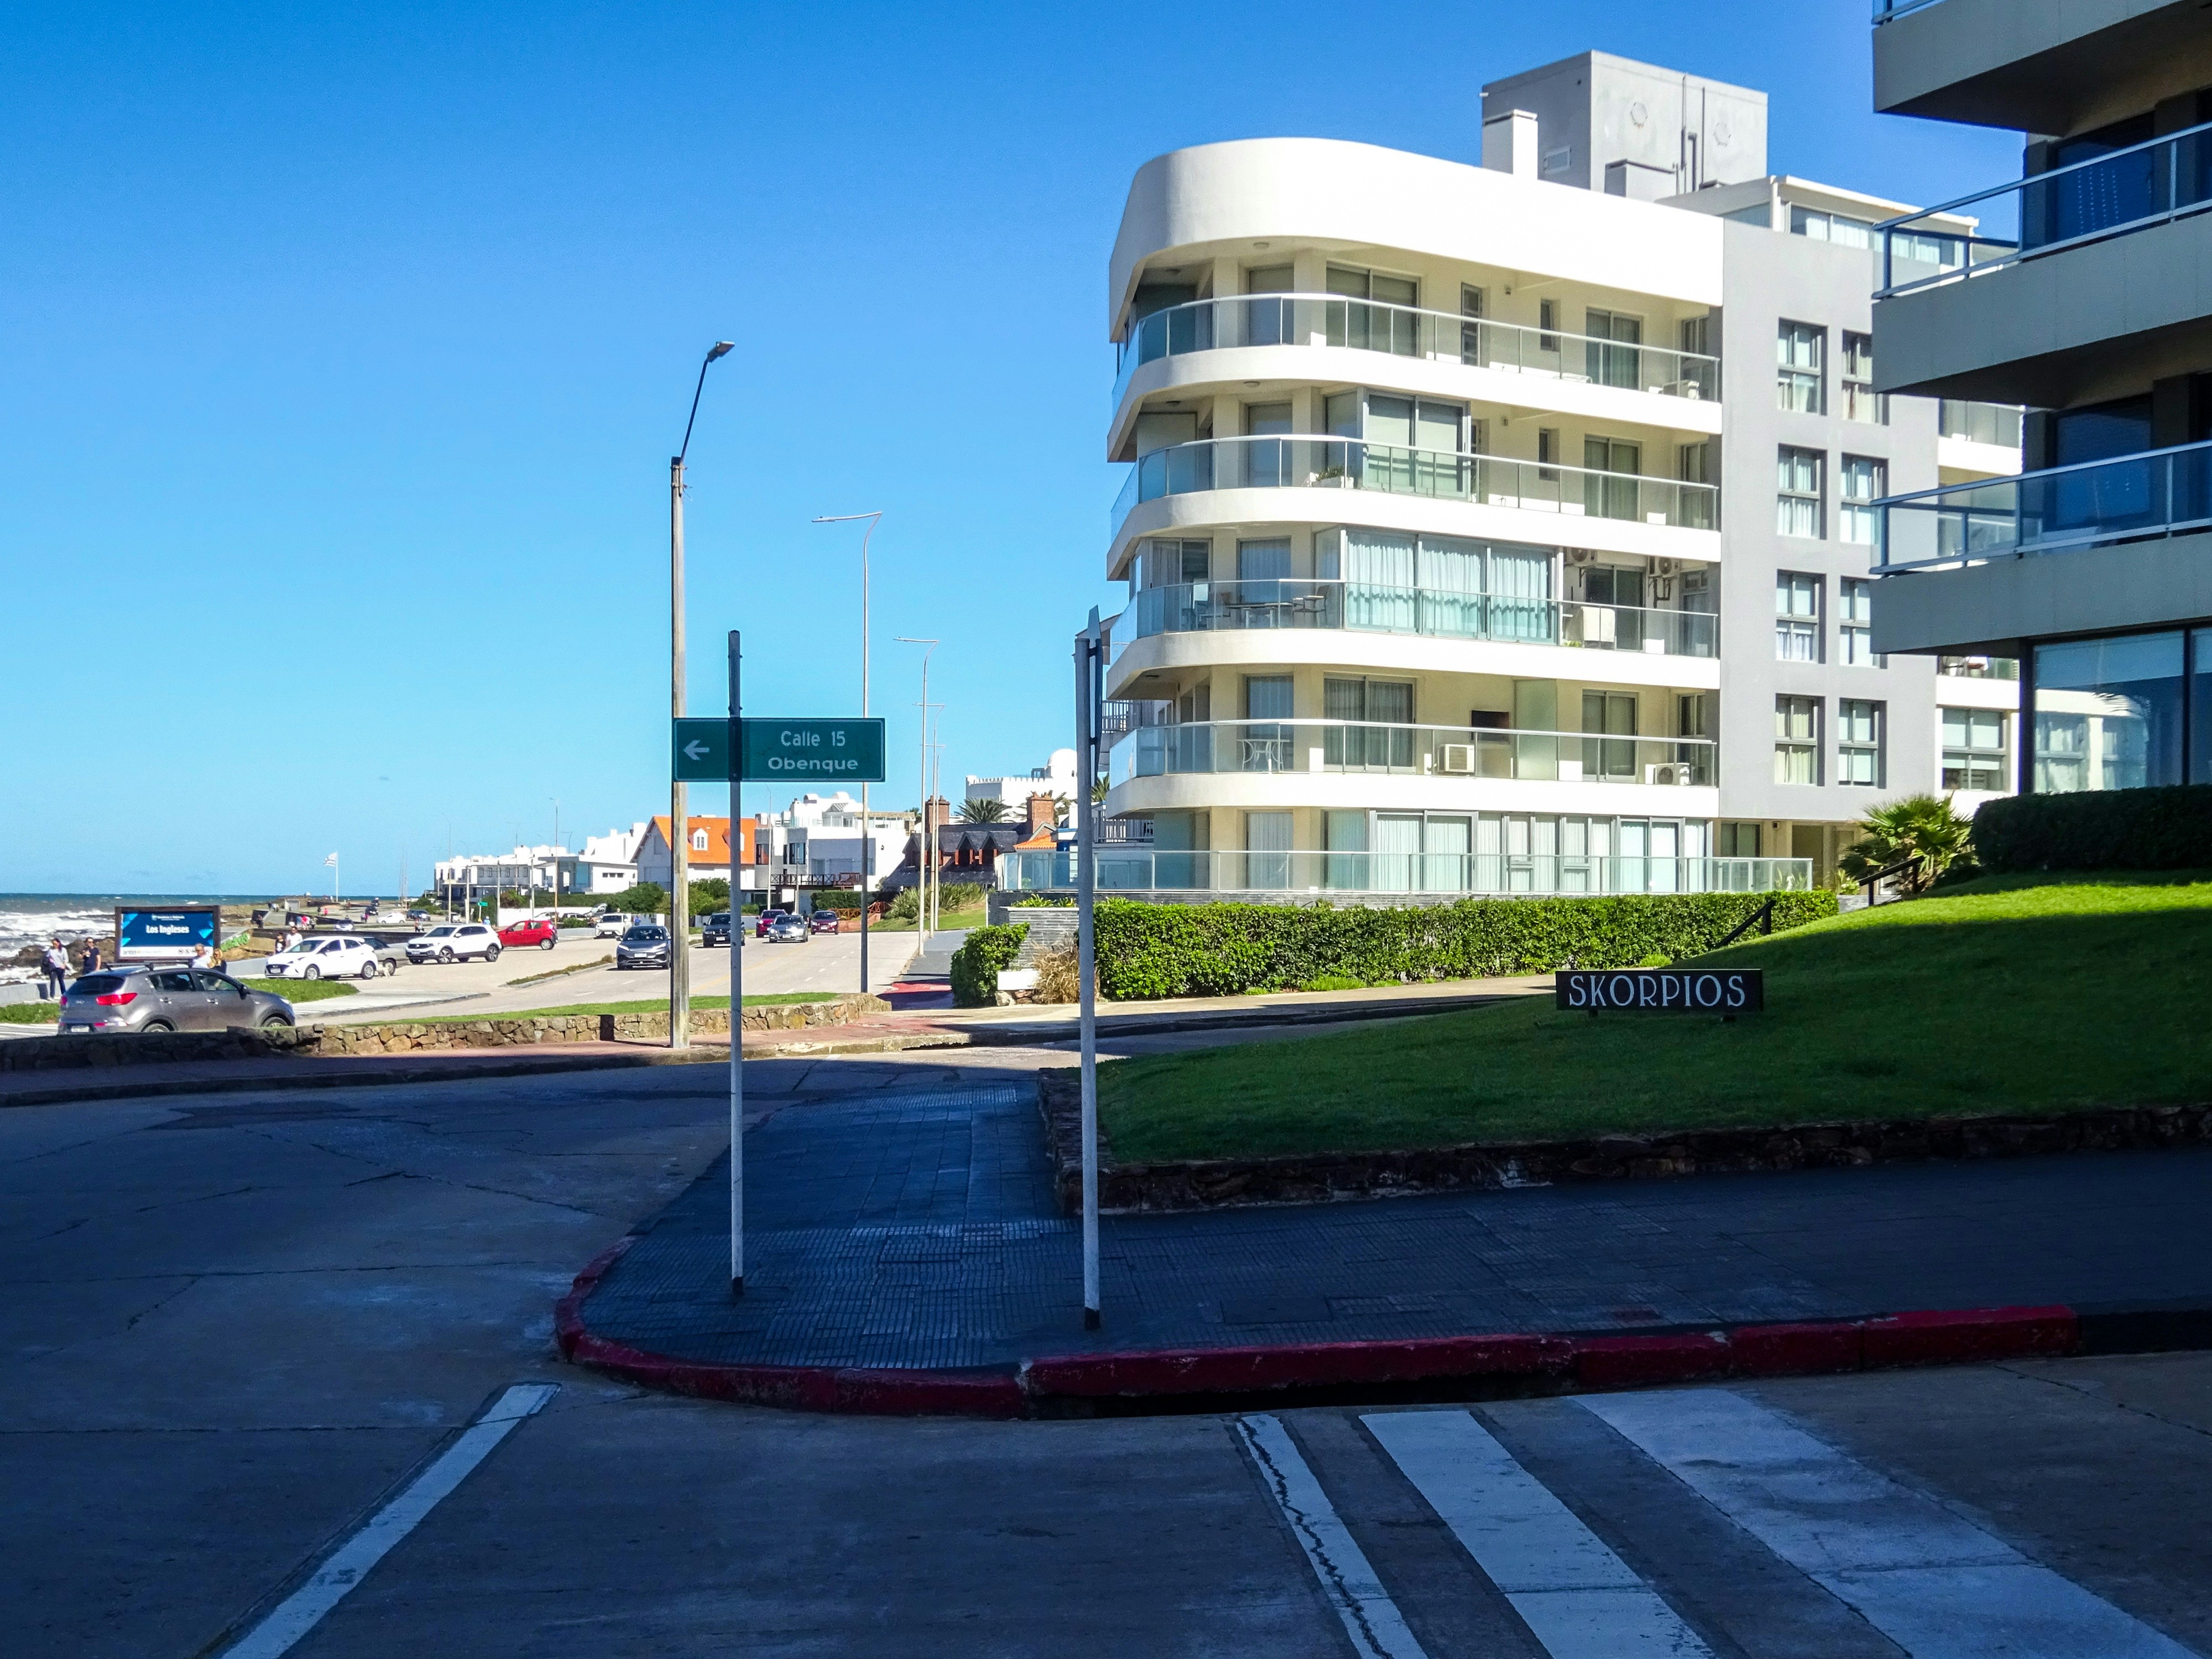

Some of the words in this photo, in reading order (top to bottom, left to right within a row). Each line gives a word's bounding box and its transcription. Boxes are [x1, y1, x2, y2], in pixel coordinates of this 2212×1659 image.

[780, 731, 821, 747] Calle
[832, 731, 846, 747] 15
[768, 757, 858, 773] Obenque
[146, 925, 158, 933] Los
[159, 925, 190, 935] Ingleses
[1569, 974, 1745, 1006] SKORPIOS
